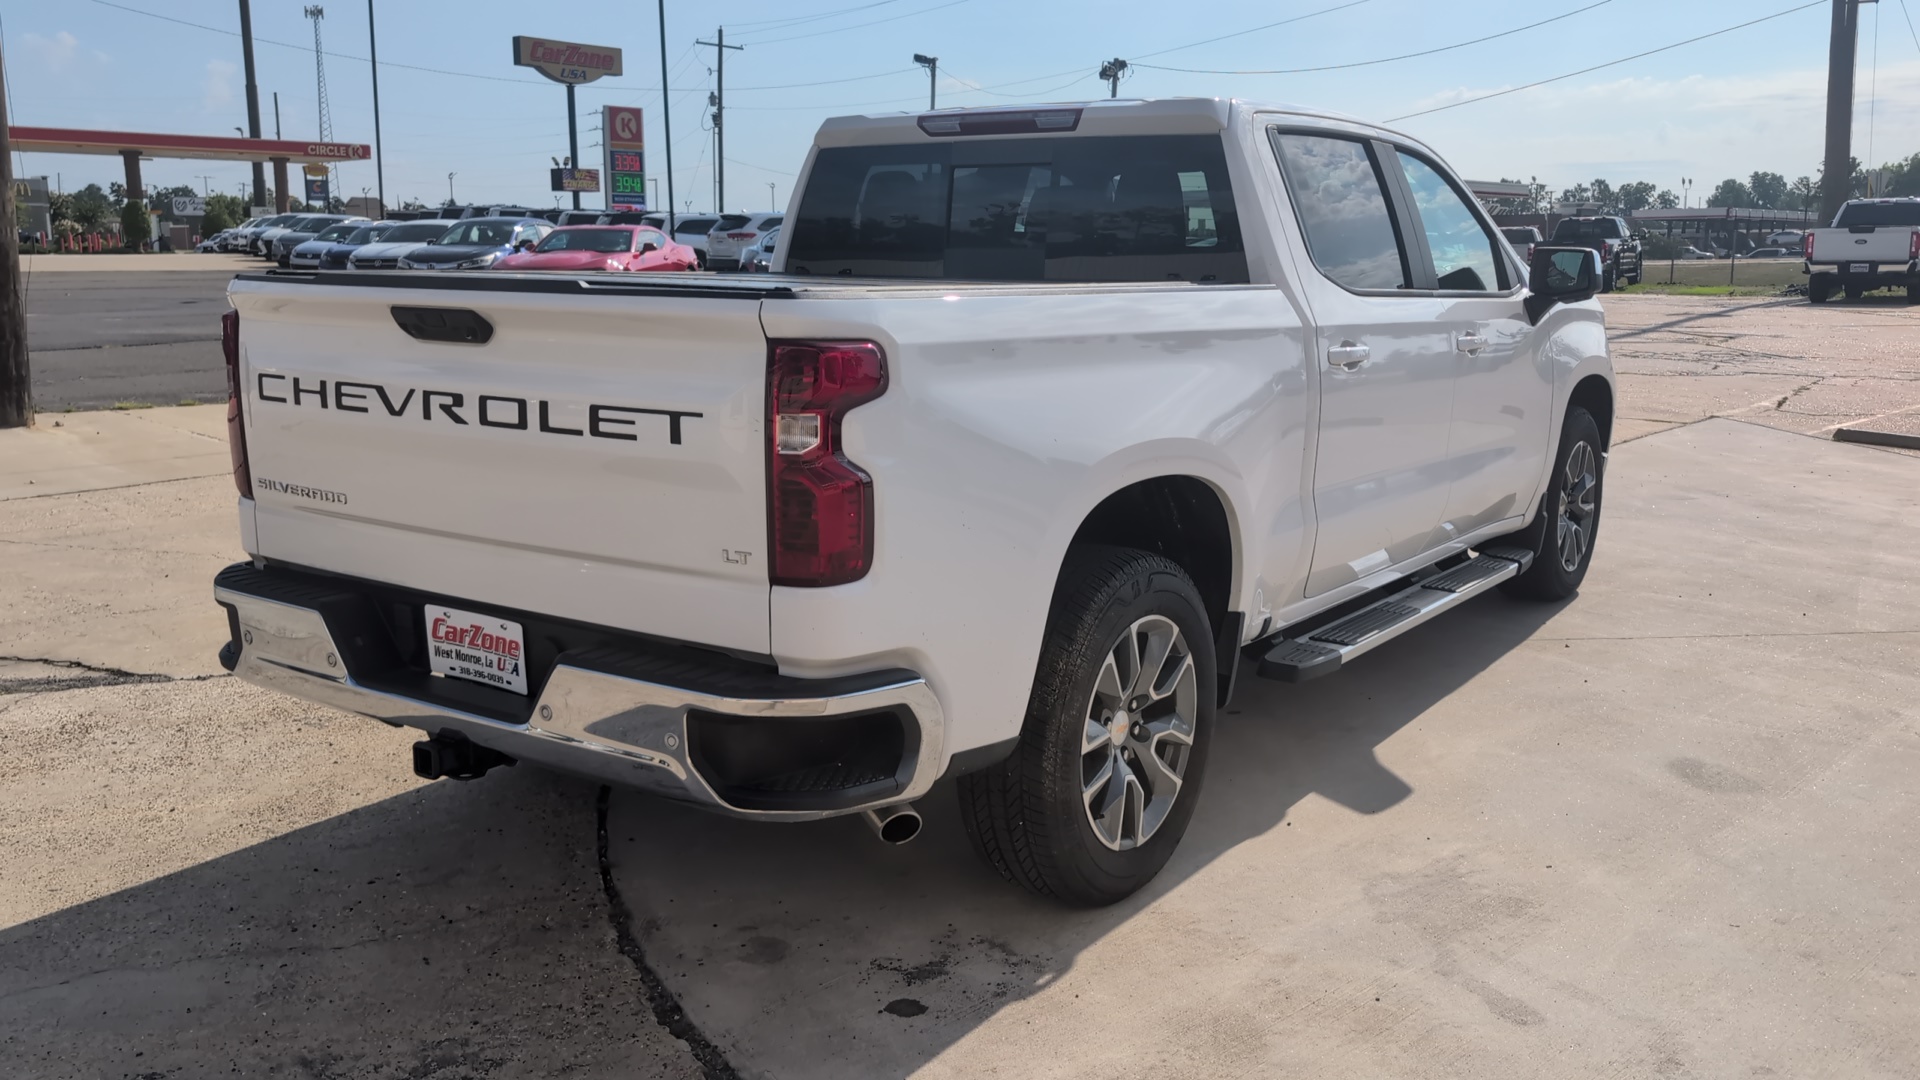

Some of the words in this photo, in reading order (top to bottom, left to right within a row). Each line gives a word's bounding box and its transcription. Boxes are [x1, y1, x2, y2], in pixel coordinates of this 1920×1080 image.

[529, 41, 615, 70] CarZone
[560, 68, 587, 81] USA
[307, 144, 347, 157] CIRCLE
[349, 145, 363, 159] K
[257, 372, 704, 446] CHEVROLET
[257, 477, 348, 505] SILVERADO
[722, 548, 752, 565] LT
[432, 617, 521, 660] CarZone
[434, 645, 454, 660] West
[454, 649, 485, 668] Monroe,
[485, 655, 494, 668] La
[497, 657, 519, 677] USA
[459, 666, 504, 684] 318-396-0039
